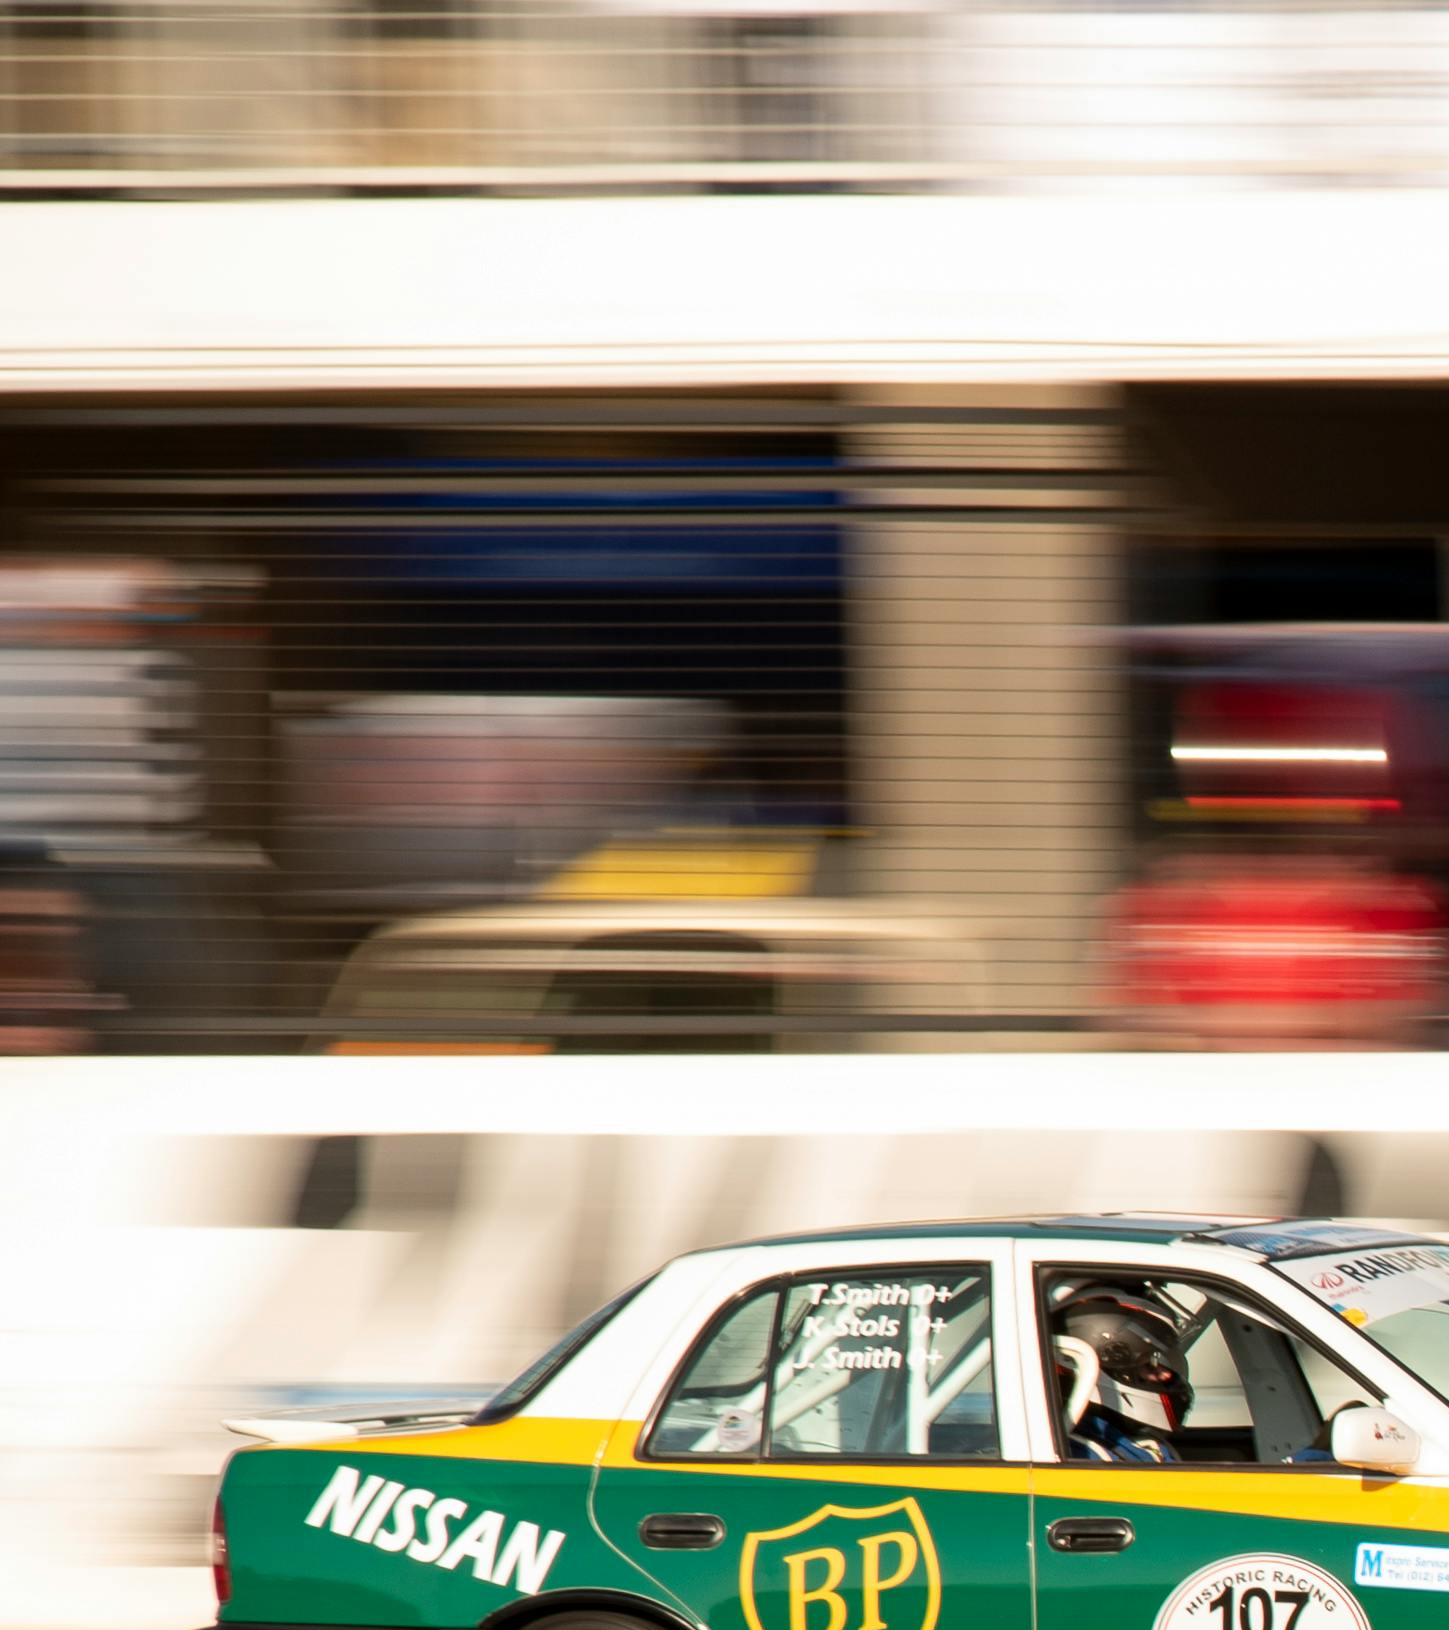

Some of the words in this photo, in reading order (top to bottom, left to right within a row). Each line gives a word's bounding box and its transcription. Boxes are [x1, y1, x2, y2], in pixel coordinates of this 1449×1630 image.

[822, 1346, 902, 1369] Smith
[304, 1465, 566, 1595] NISSAN
[1185, 1570, 1266, 1616] HISTORIC
[1272, 1570, 1337, 1613] RACING
